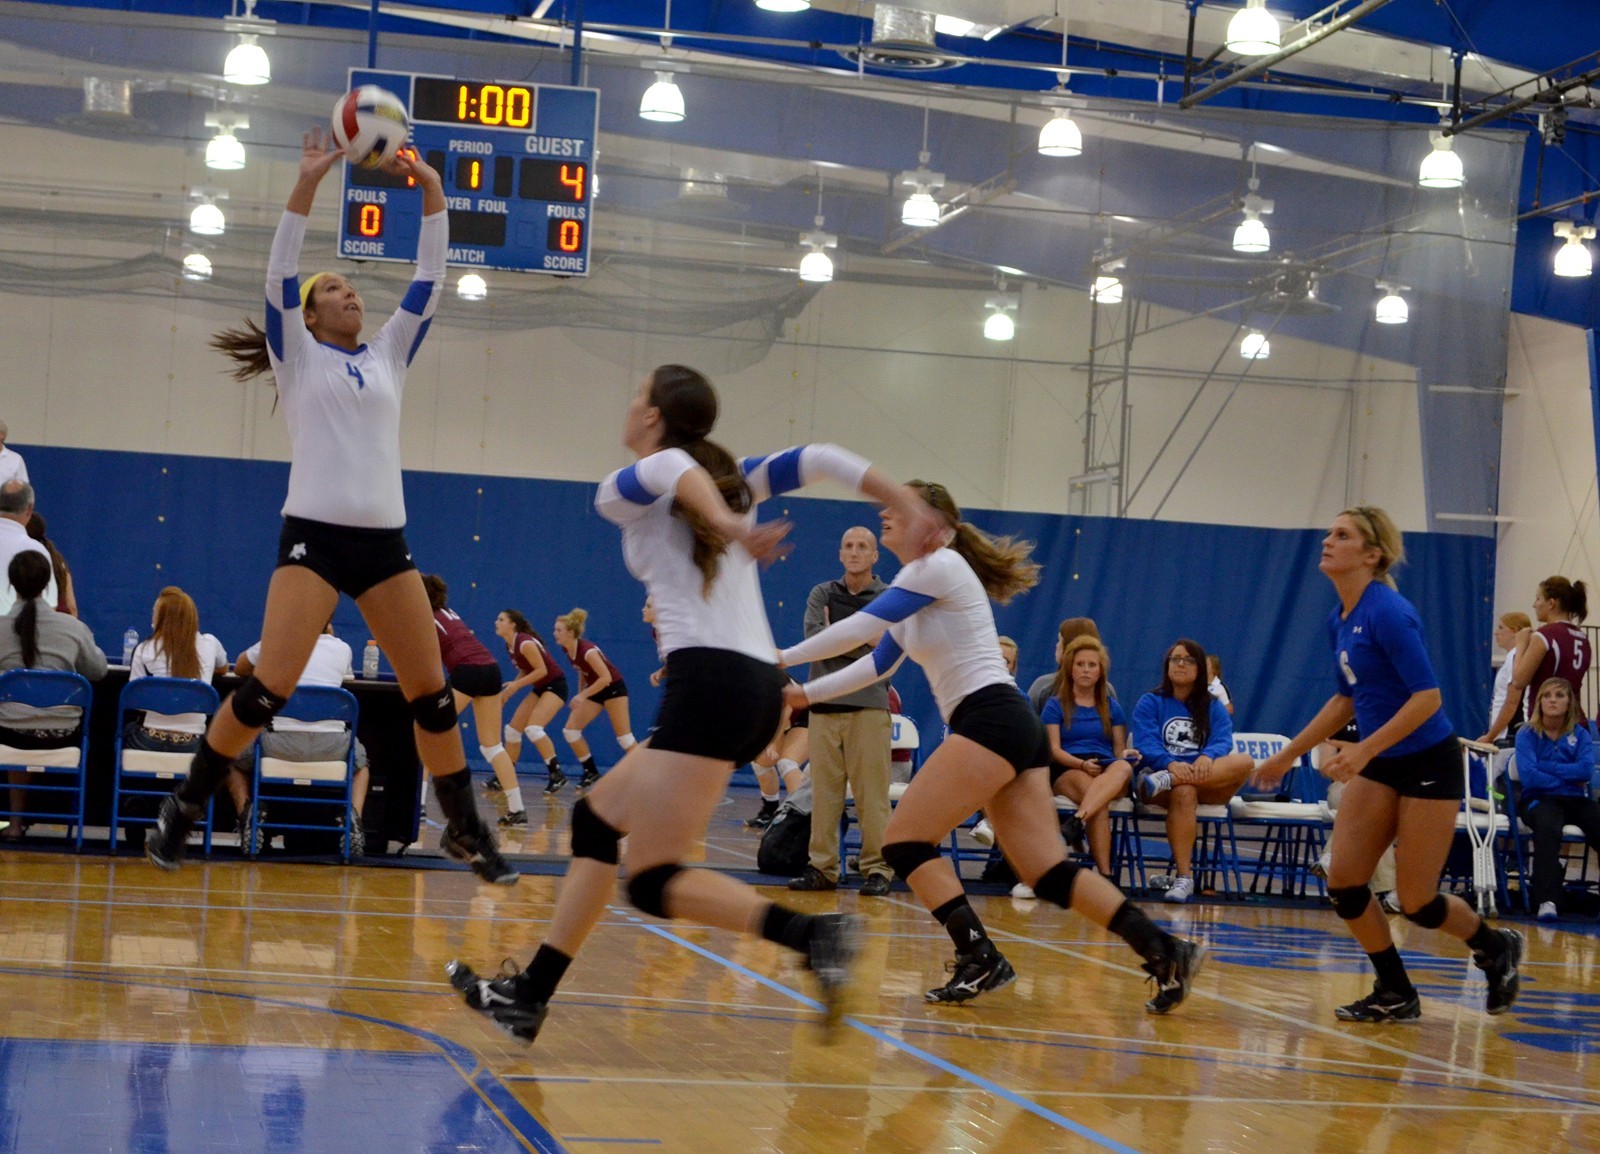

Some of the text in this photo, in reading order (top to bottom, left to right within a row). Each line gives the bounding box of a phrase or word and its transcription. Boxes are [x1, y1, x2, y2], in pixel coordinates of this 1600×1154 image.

[458, 85, 530, 127] 1:00
[449, 139, 493, 155] PERIOD
[525, 135, 584, 157] GUEST
[471, 161, 479, 188] 1
[561, 165, 583, 200] 4
[347, 188, 388, 204] FOULS
[477, 199, 509, 214] FOUL
[360, 204, 380, 236] 0
[547, 204, 586, 219] FOULS
[560, 220, 579, 252] 0
[343, 240, 385, 256] SCORE
[543, 255, 584, 271] SCORE
[345, 361, 365, 390] 4
[1572, 639, 1584, 670] 5
[1235, 739, 1283, 760] PERU
